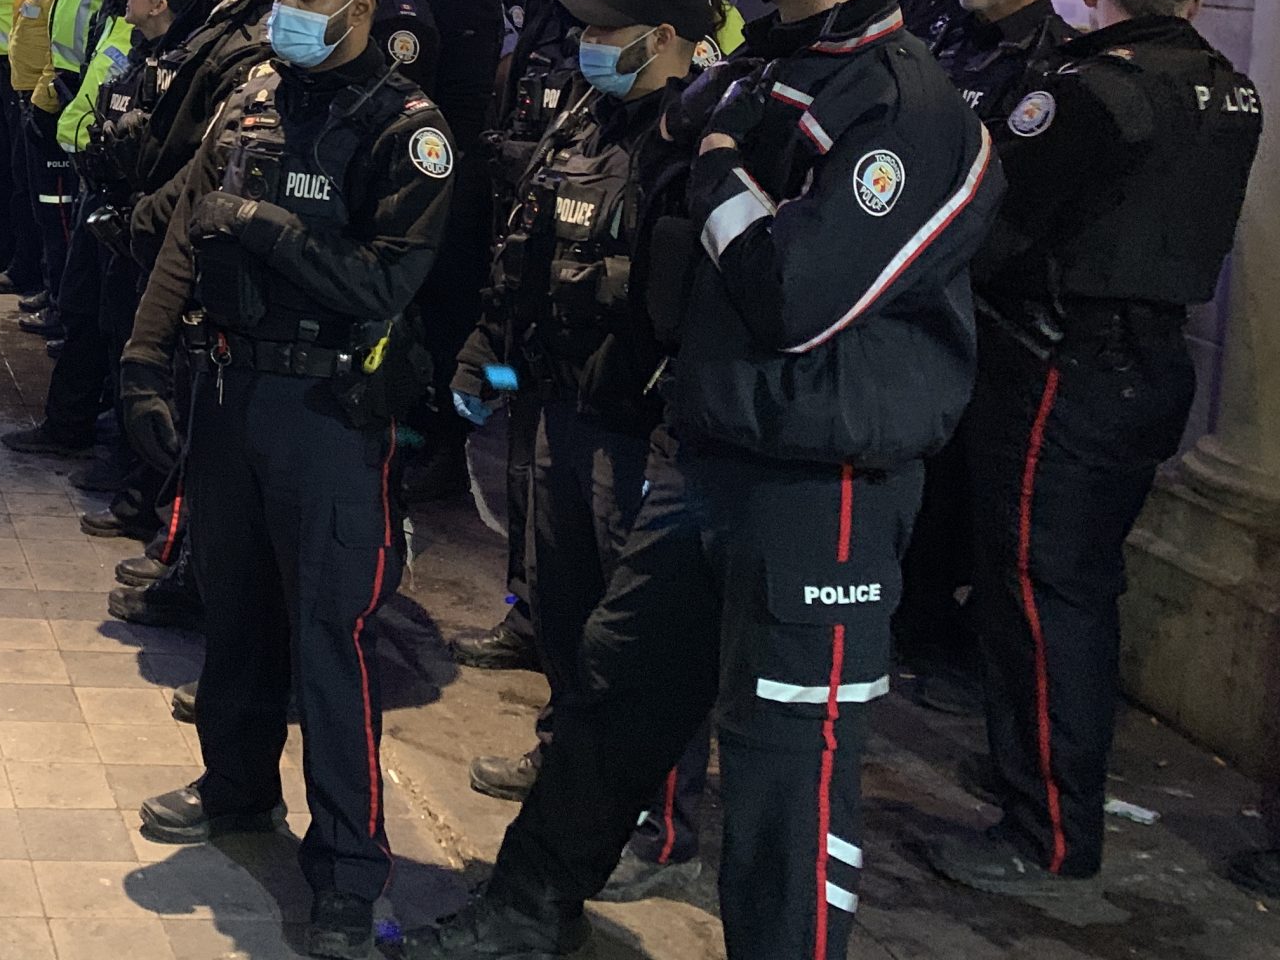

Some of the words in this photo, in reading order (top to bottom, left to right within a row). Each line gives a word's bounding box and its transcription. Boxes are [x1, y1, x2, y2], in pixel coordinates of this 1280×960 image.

[1194, 85, 1259, 113] PLICE
[46, 160, 70, 168] POLIC
[422, 161, 446, 174] POLICE
[875, 154, 901, 182] TORONTO
[285, 171, 332, 201] POLICE
[859, 185, 884, 211] POLICE
[554, 196, 595, 227] POLICE
[804, 583, 881, 605] POLICE
